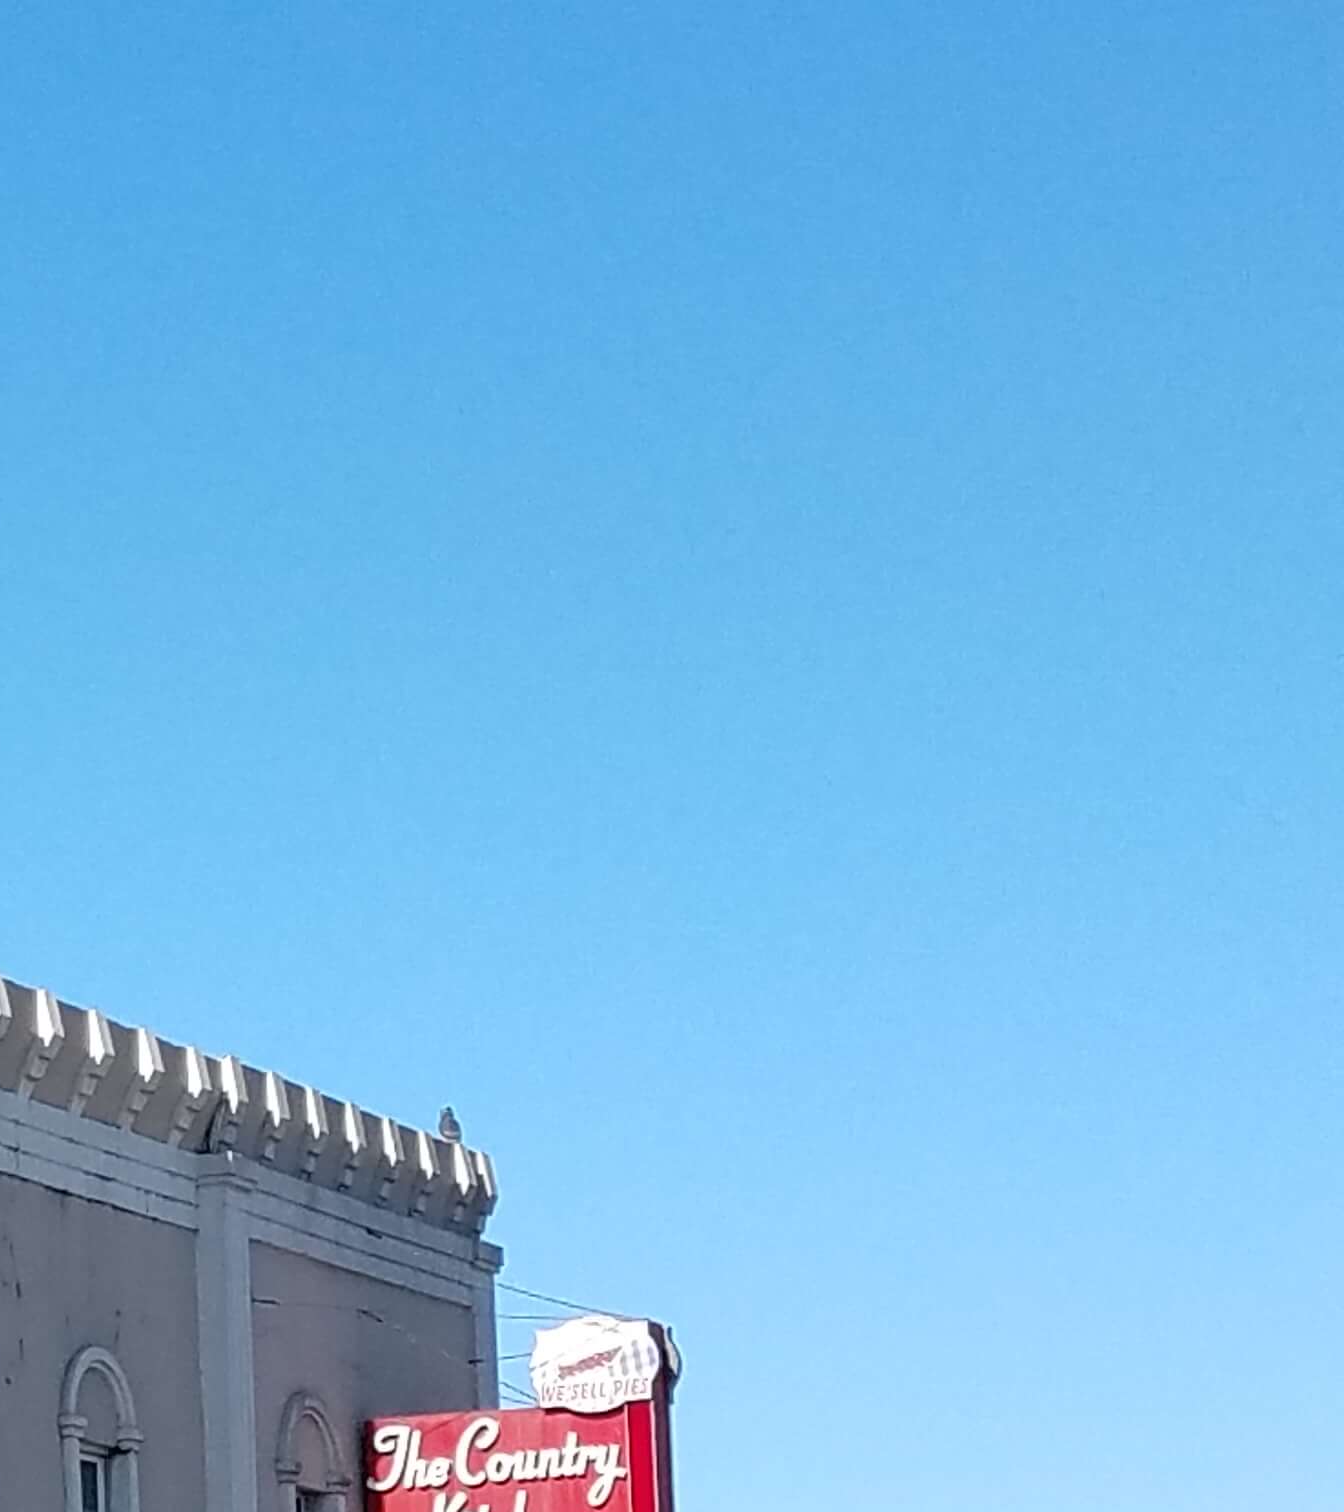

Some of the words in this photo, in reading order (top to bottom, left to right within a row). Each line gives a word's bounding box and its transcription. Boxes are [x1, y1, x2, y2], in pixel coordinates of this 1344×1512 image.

[541, 1382, 564, 1402] WE
[571, 1382, 607, 1401] SELL
[614, 1378, 649, 1396] PIES
[366, 1424, 453, 1493] The
[455, 1416, 629, 1509] Country
